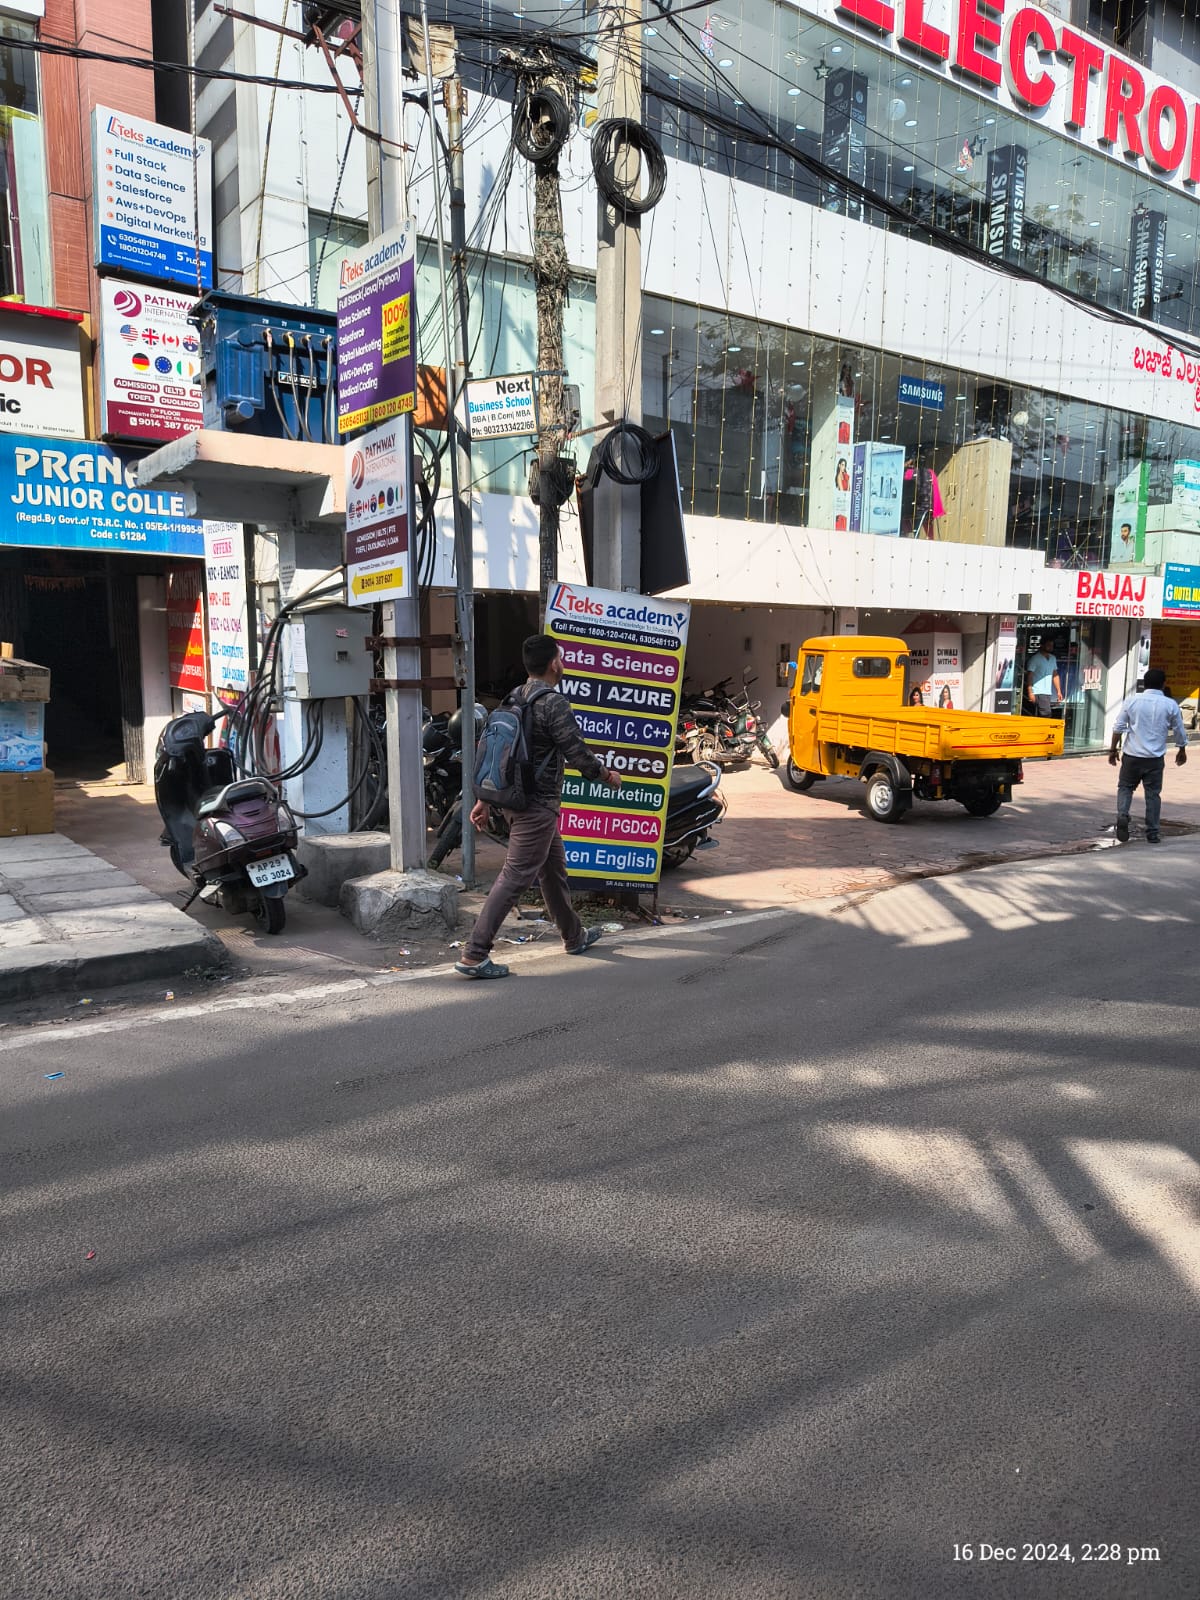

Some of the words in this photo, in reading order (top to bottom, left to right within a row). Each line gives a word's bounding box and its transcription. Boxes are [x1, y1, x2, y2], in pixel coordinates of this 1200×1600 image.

[837, 0, 1200, 184] LECTRO
[117, 124, 144, 142] Teks
[115, 148, 134, 162] Full
[136, 152, 167, 172] Stack
[115, 165, 142, 181] Data
[144, 172, 186, 192] Science
[115, 180, 172, 204] Salesforce
[1012, 154, 1025, 250] SAMSUNG
[116, 197, 186, 224] Aws+DevOps
[116, 212, 151, 230] Digital
[989, 173, 1007, 259] SAMSU
[346, 262, 364, 282] Teks
[364, 234, 406, 273] academy
[1153, 220, 1166, 304] SAMSUNG
[144, 294, 193, 311] PATHWA
[144, 307, 187, 320] INTERNATIO
[338, 297, 348, 310] Full
[339, 316, 350, 328] Data
[351, 306, 371, 322] Science
[384, 301, 408, 327] 100%
[339, 328, 365, 346] Salesforce
[340, 348, 355, 366] Digital
[356, 338, 382, 356] Marketing
[1134, 345, 1173, 378] బజాజ్
[340, 362, 374, 383] AWS+DevOps
[116, 380, 158, 392] ADMISSION
[165, 386, 184, 396] IELTS
[340, 384, 359, 399] Medical
[360, 377, 378, 392] Coding
[496, 378, 530, 395] Next
[902, 384, 942, 402] SAMSUNG
[130, 394, 152, 402] TOEFL
[161, 398, 199, 408] DUOLINGO
[340, 402, 350, 414] SAP
[387, 403, 396, 414] 120
[398, 396, 413, 412] 4748
[469, 400, 504, 413] Business
[506, 394, 532, 408] School
[138, 418, 160, 427] 9014
[366, 433, 396, 460] PATHWAY
[10, 483, 104, 510] JUNIOR
[112, 491, 184, 517] COLLE
[854, 477, 862, 521] PlayStation
[16, 512, 56, 525] (Regd.By
[58, 514, 90, 526] Govt.of
[92, 517, 123, 528] TS.R.C.
[146, 522, 203, 535] 05/E4-1/1995-9
[90, 529, 112, 539] Code
[120, 532, 146, 541] 61284
[213, 541, 232, 554] OFFERS
[1077, 572, 1146, 602] BAJAJ
[566, 594, 604, 616] Teks
[606, 605, 686, 633] academy
[1076, 602, 1144, 616] ELECTRONICS
[554, 622, 568, 630] Toll
[569, 624, 586, 634] Free:
[588, 627, 638, 642] 1800-120-4748,
[910, 658, 921, 666] ITH
[938, 658, 952, 666] WITH
[937, 648, 958, 656] DIWALI
[601, 652, 675, 676] Science
[606, 686, 672, 708] AZURE
[575, 716, 612, 734] Stack
[625, 722, 638, 740] C,
[643, 724, 670, 739] C++
[594, 750, 666, 774] sforce
[562, 780, 584, 796] ital
[589, 783, 662, 807] Marketing
[568, 814, 601, 831] Revit
[612, 818, 658, 836] PGDCA
[565, 849, 590, 863] ken
[596, 850, 654, 870] English
[256, 874, 268, 884] BG
[270, 868, 291, 880] 3024
